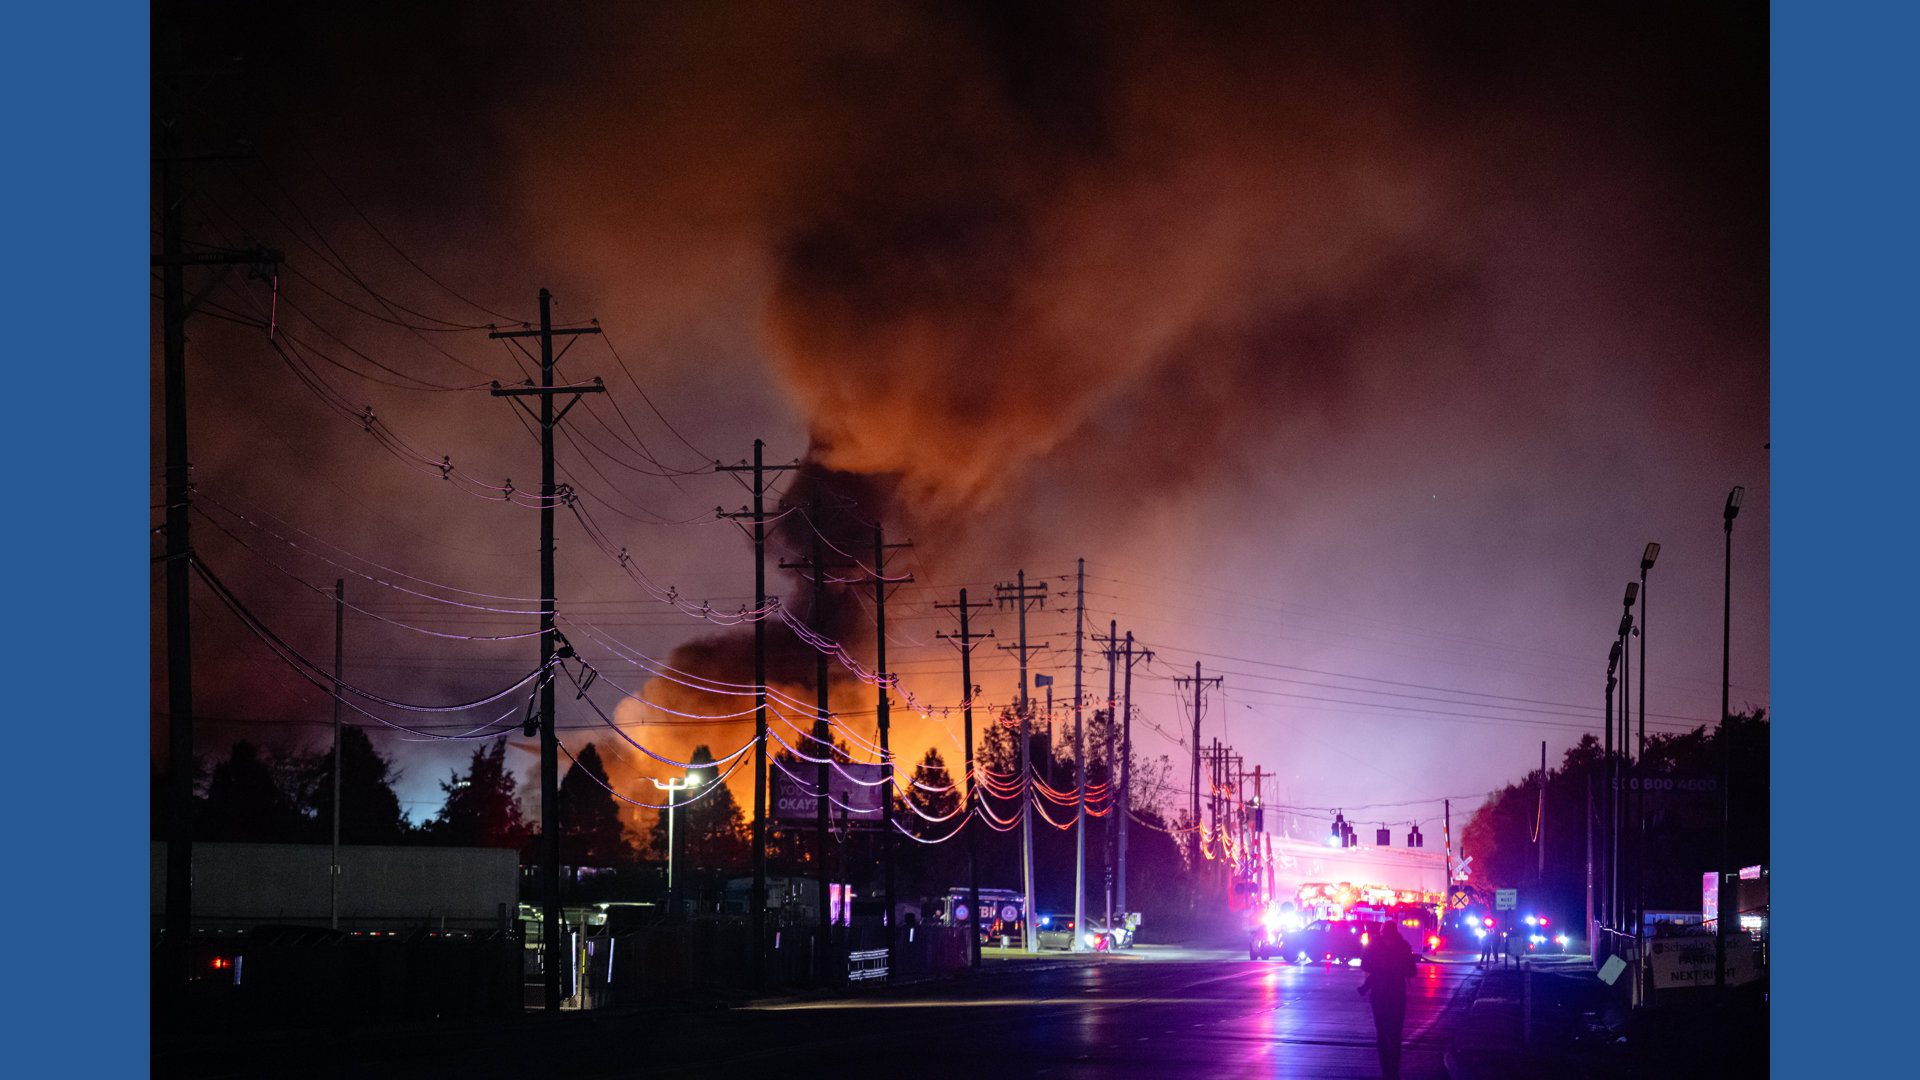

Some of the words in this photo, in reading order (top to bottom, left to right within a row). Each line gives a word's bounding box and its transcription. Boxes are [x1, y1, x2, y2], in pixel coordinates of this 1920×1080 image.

[1644, 777, 1674, 790] 800
[778, 798, 818, 810] OKAY?
[1671, 969, 1698, 981] NEXT
[1703, 967, 1737, 979] RIHT
